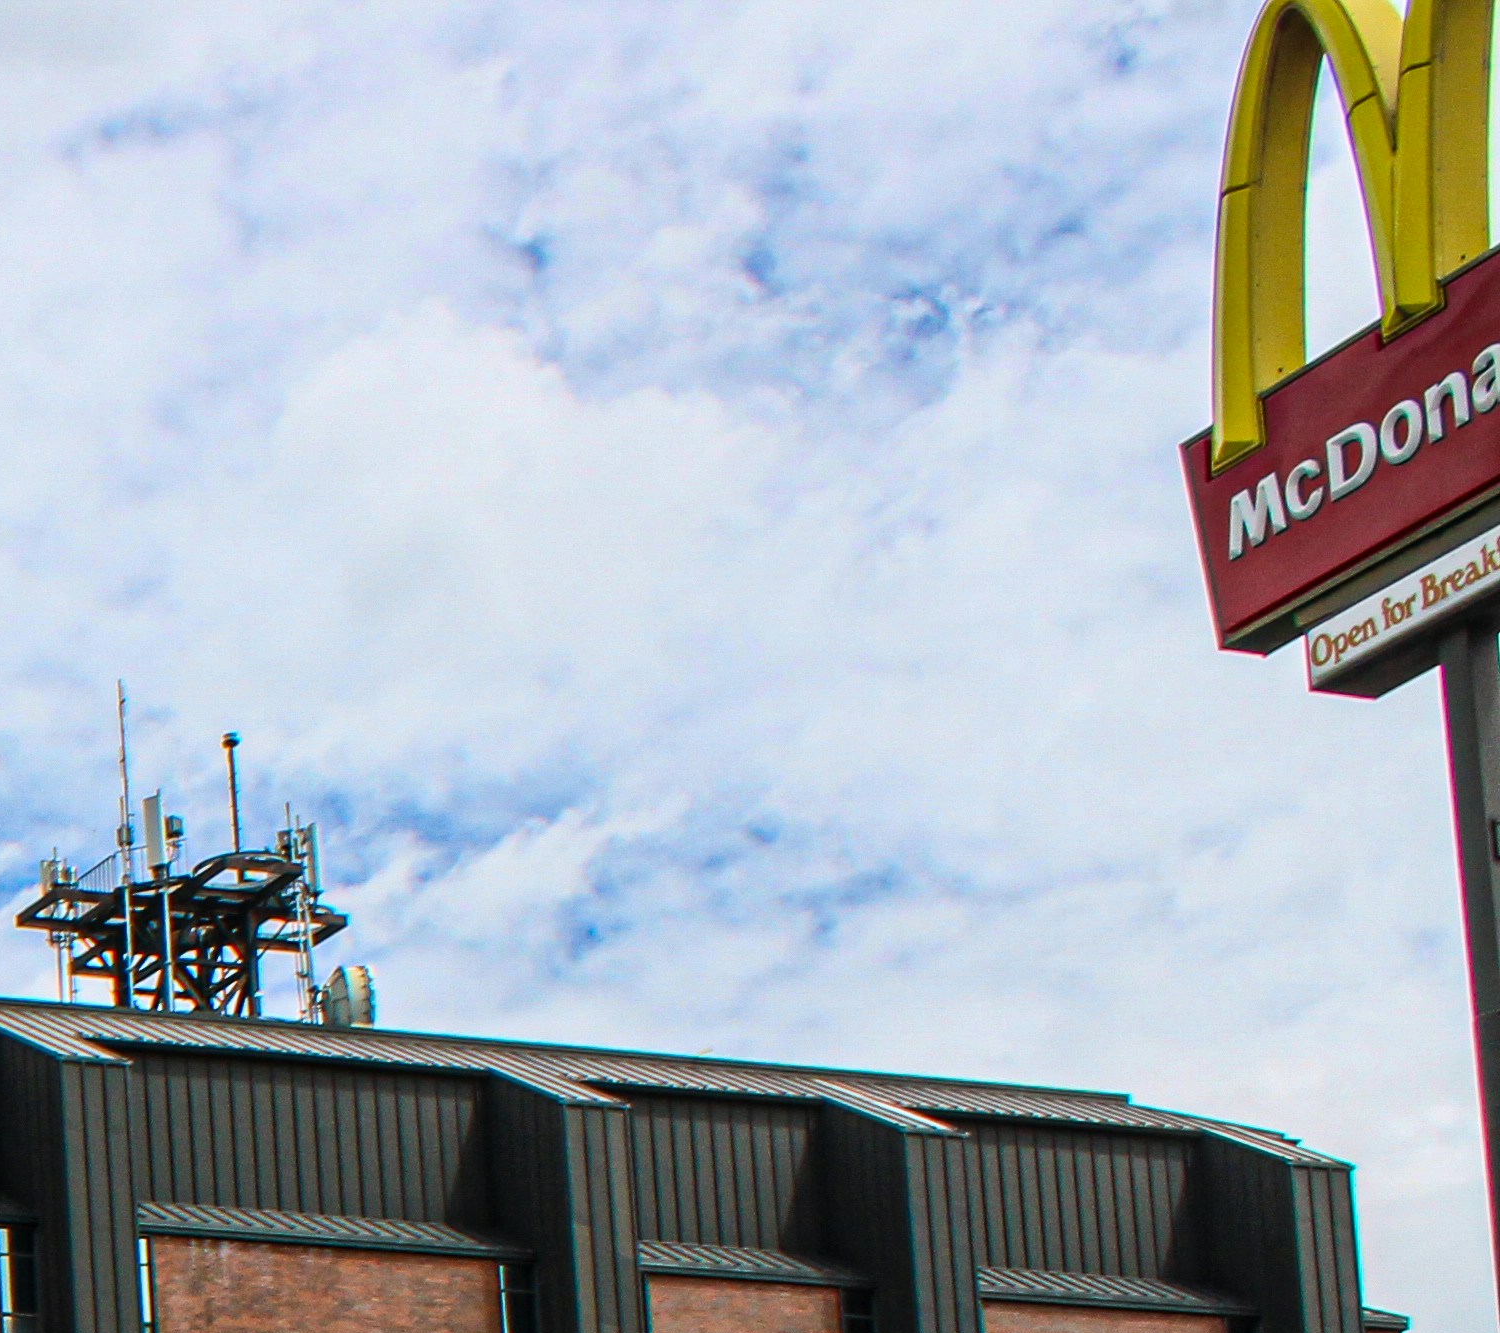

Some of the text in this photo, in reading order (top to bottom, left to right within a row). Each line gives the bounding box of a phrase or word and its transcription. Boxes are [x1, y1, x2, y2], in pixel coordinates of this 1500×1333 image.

[1311, 535, 1500, 667] Open for Break
